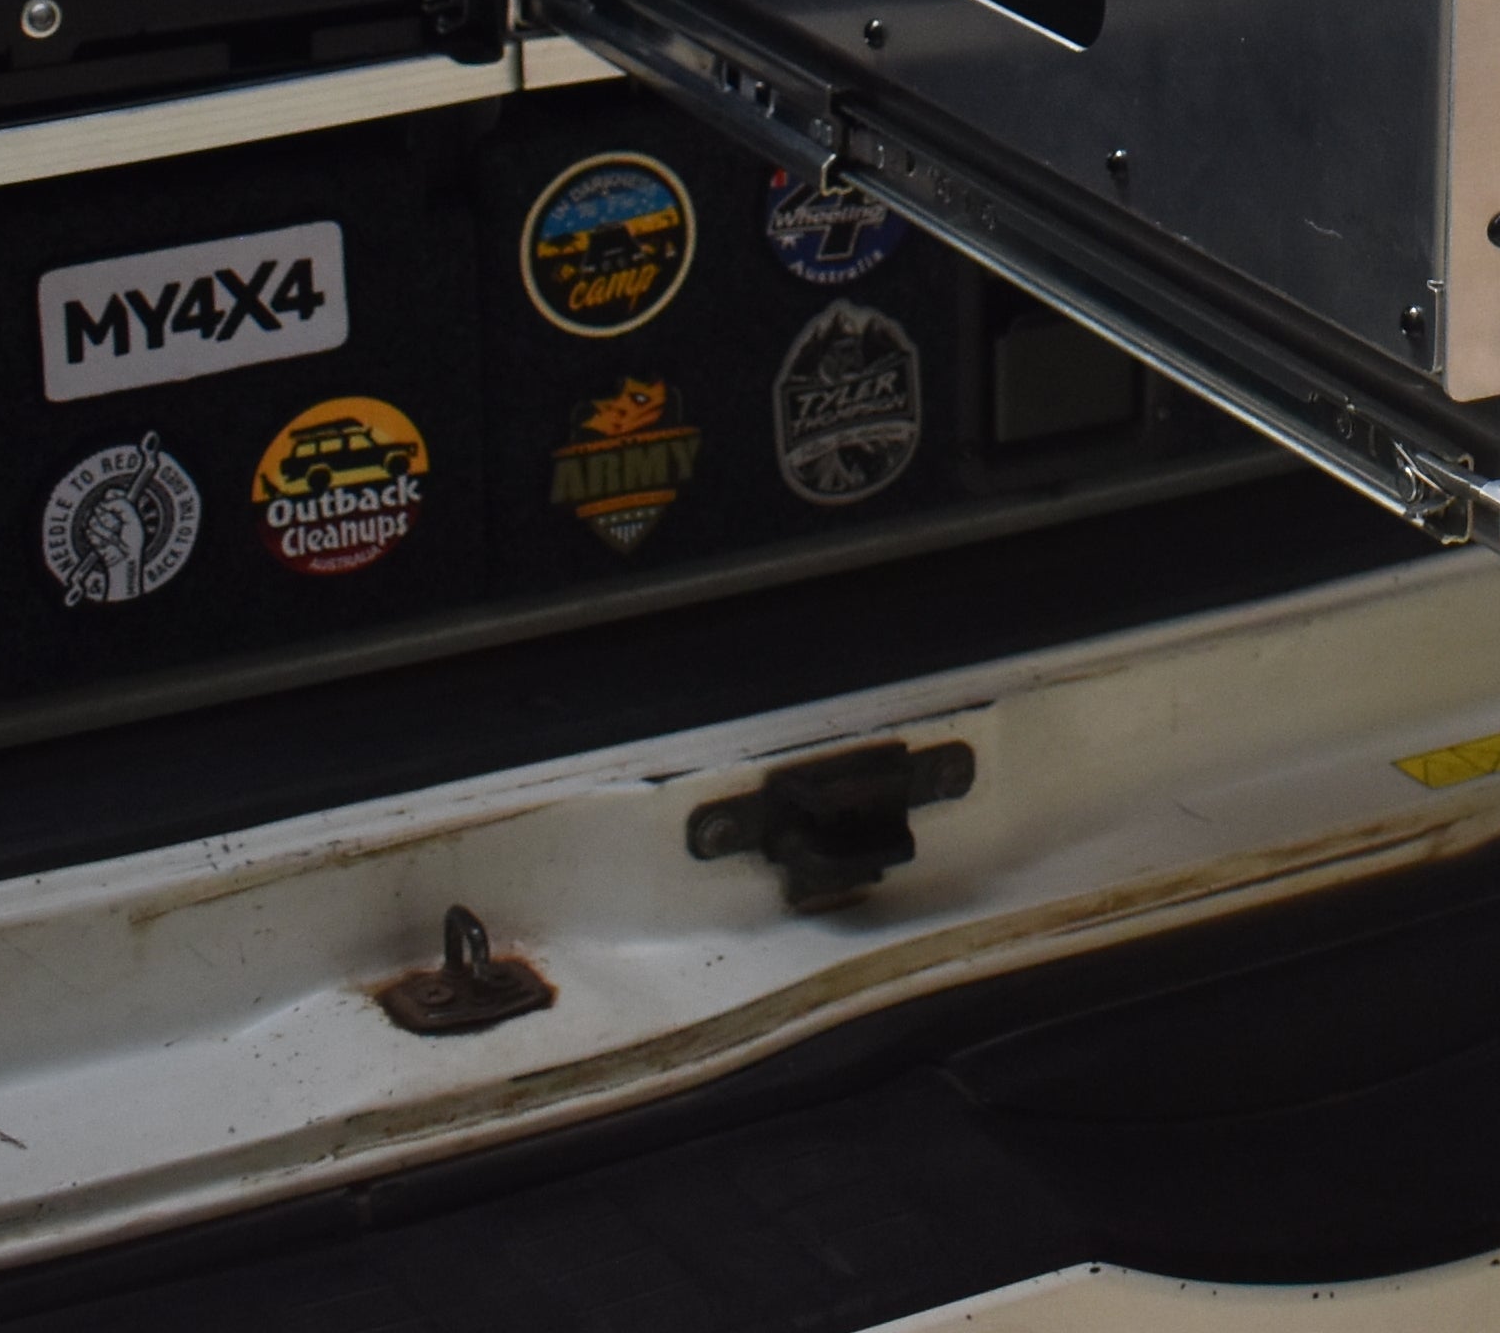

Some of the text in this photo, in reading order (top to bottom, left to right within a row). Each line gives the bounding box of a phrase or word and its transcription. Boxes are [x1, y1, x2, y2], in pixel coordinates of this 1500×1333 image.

[63, 258, 326, 364] MY4X4
[794, 369, 899, 417] TYLER
[266, 474, 423, 529] Outback
[550, 436, 702, 505] ARMY
[50, 452, 139, 573] NEEDLE TO RED
[281, 511, 410, 559] Cleanups
